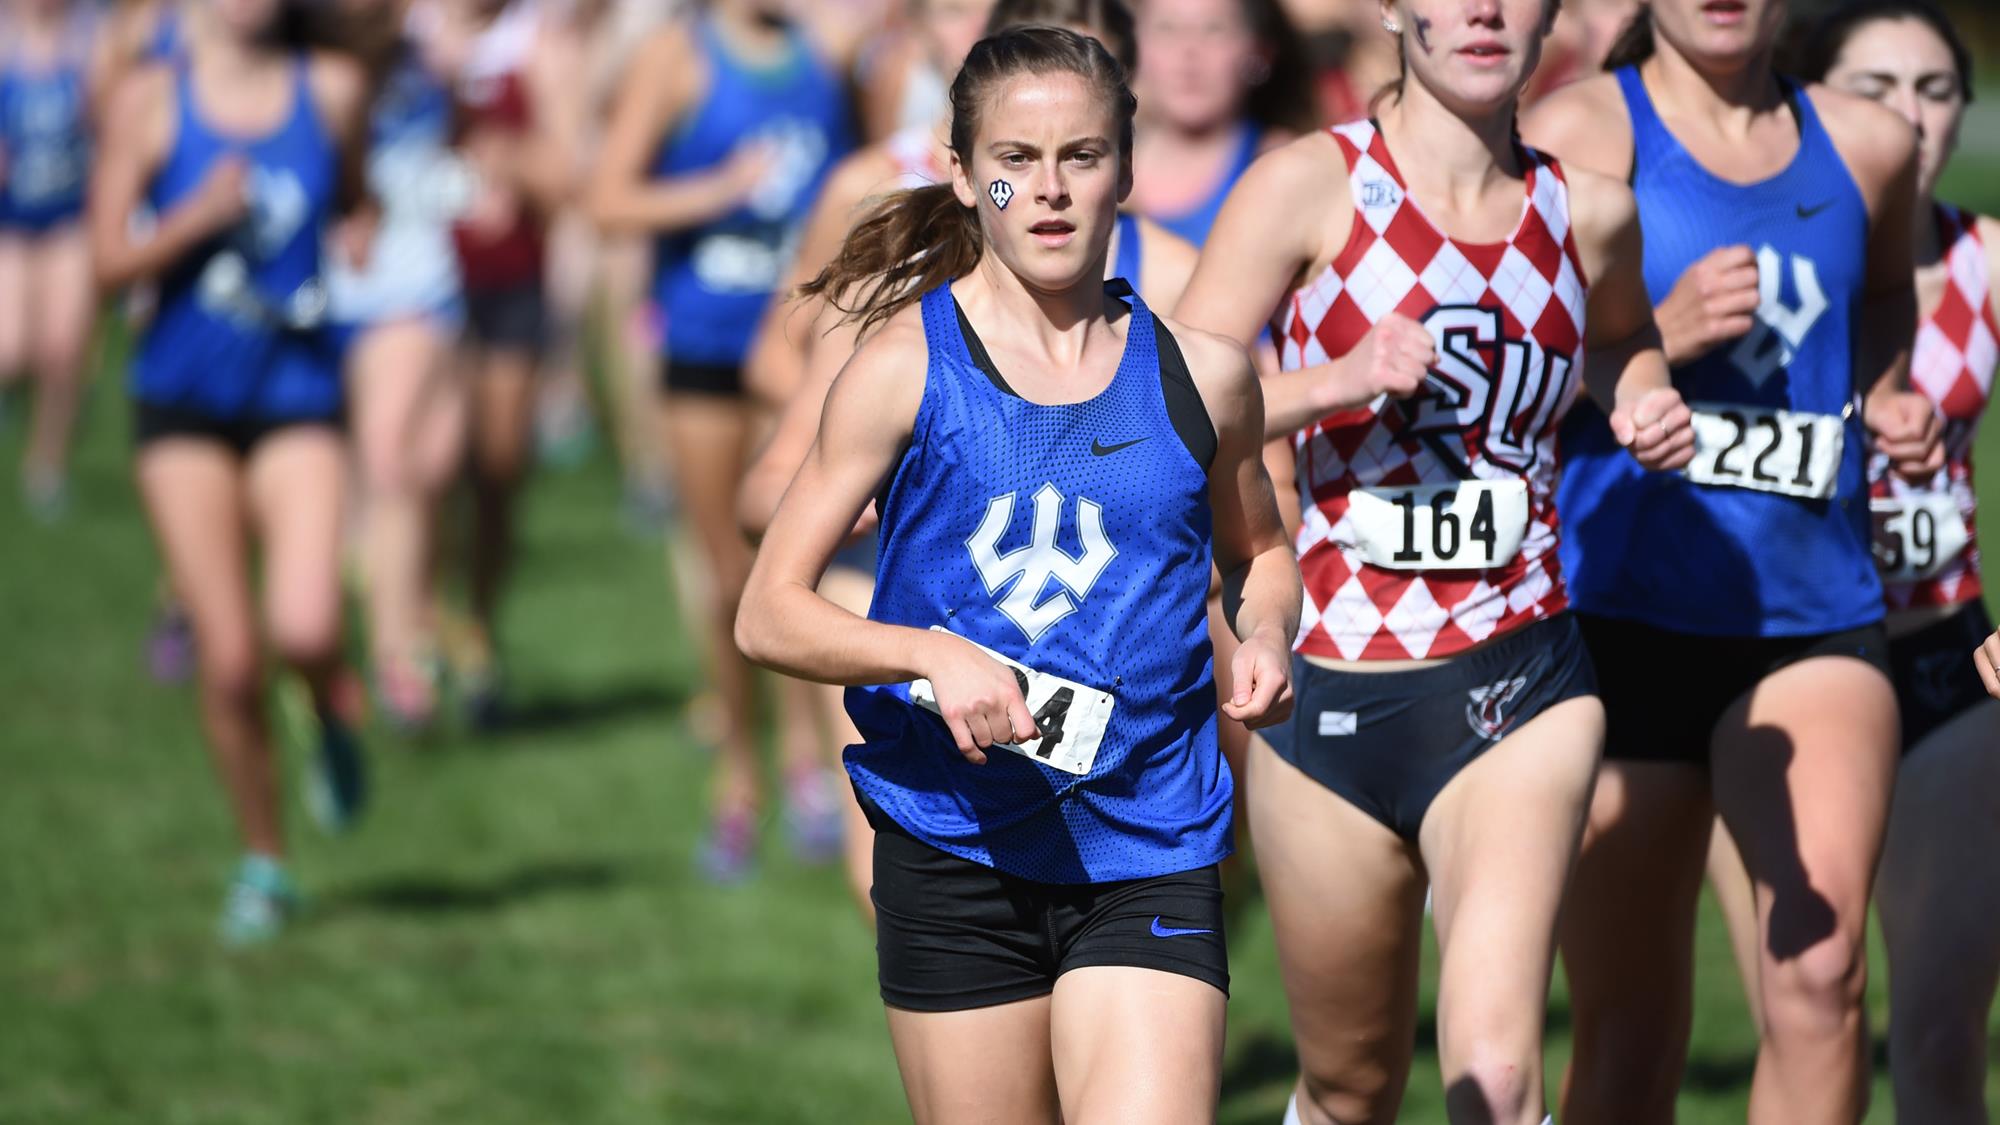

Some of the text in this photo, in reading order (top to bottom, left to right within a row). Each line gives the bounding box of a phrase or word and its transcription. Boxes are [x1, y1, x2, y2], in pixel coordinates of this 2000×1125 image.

[1398, 304, 1573, 474] SU
[1713, 411, 1813, 488] 221
[1392, 489, 1497, 562] 164
